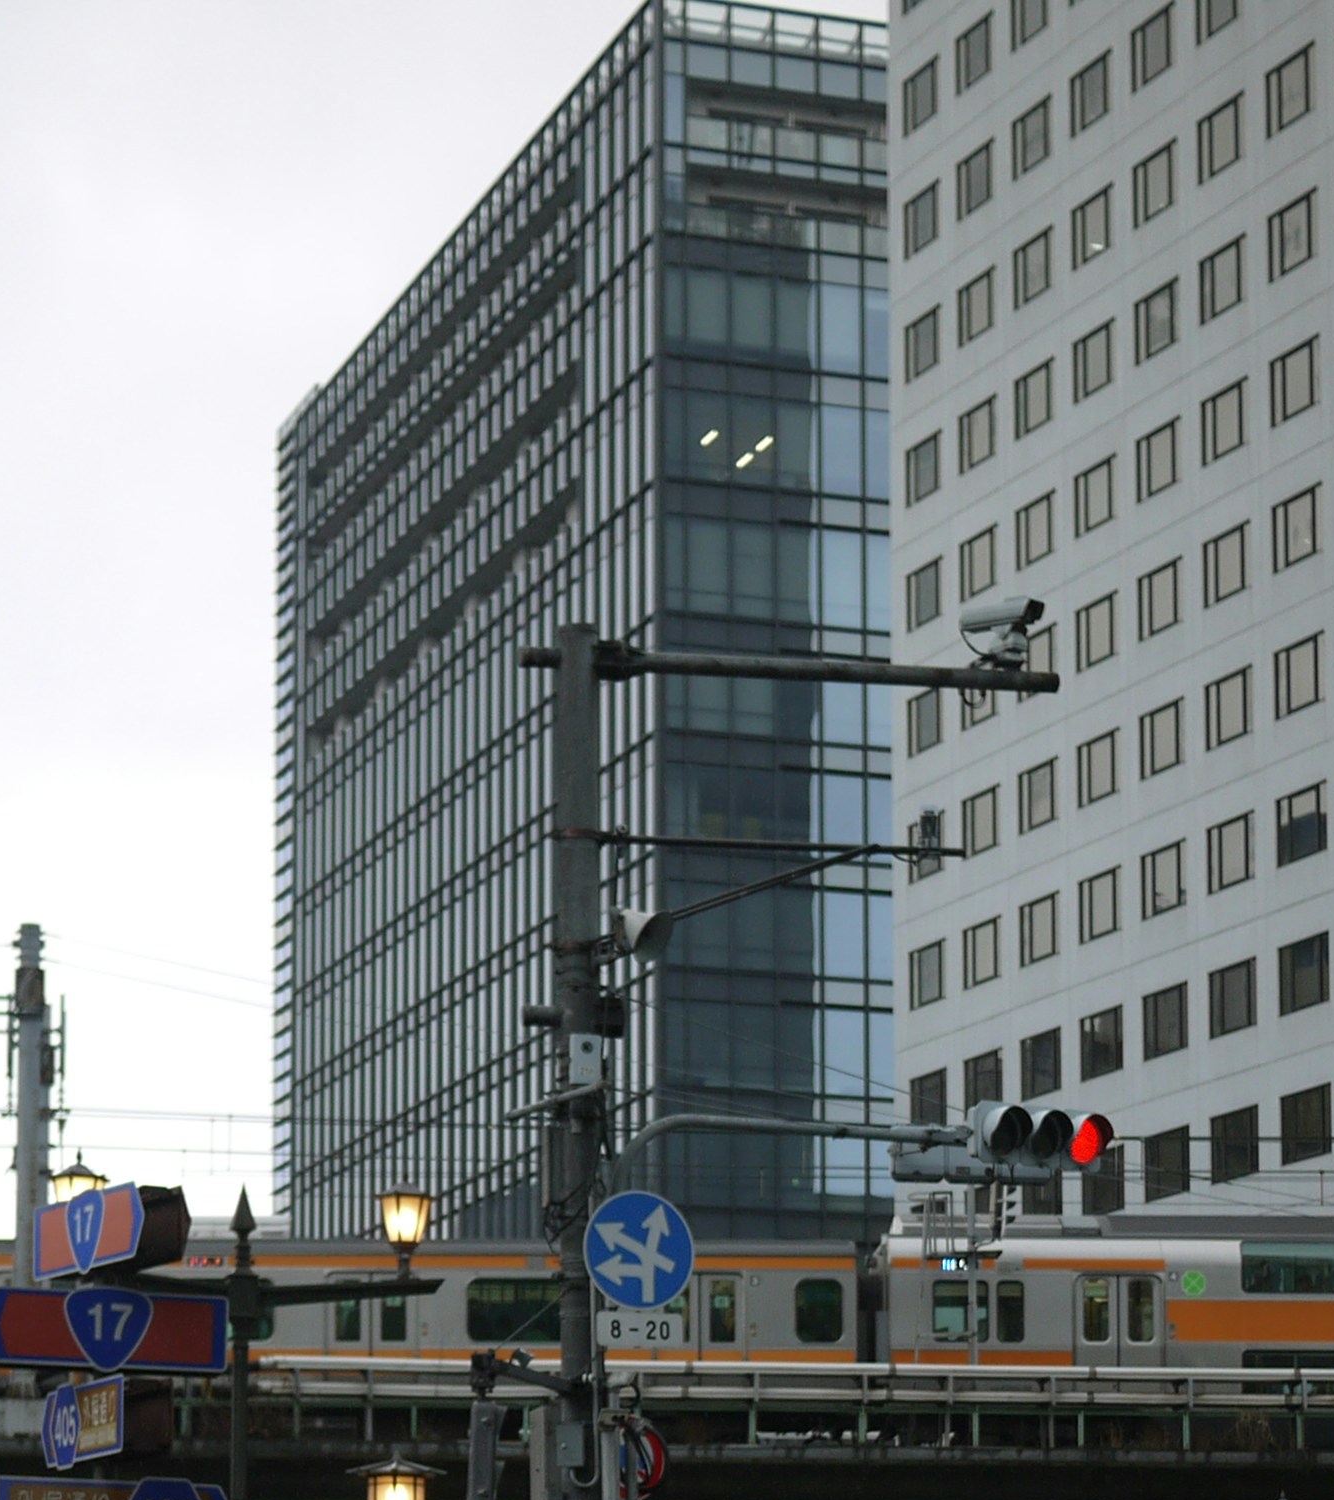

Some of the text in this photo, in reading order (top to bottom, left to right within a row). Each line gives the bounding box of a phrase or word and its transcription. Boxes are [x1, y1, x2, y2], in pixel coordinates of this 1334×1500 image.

[73, 1204, 94, 1245] 17
[87, 1303, 134, 1341] 17
[54, 1404, 76, 1449] 405
